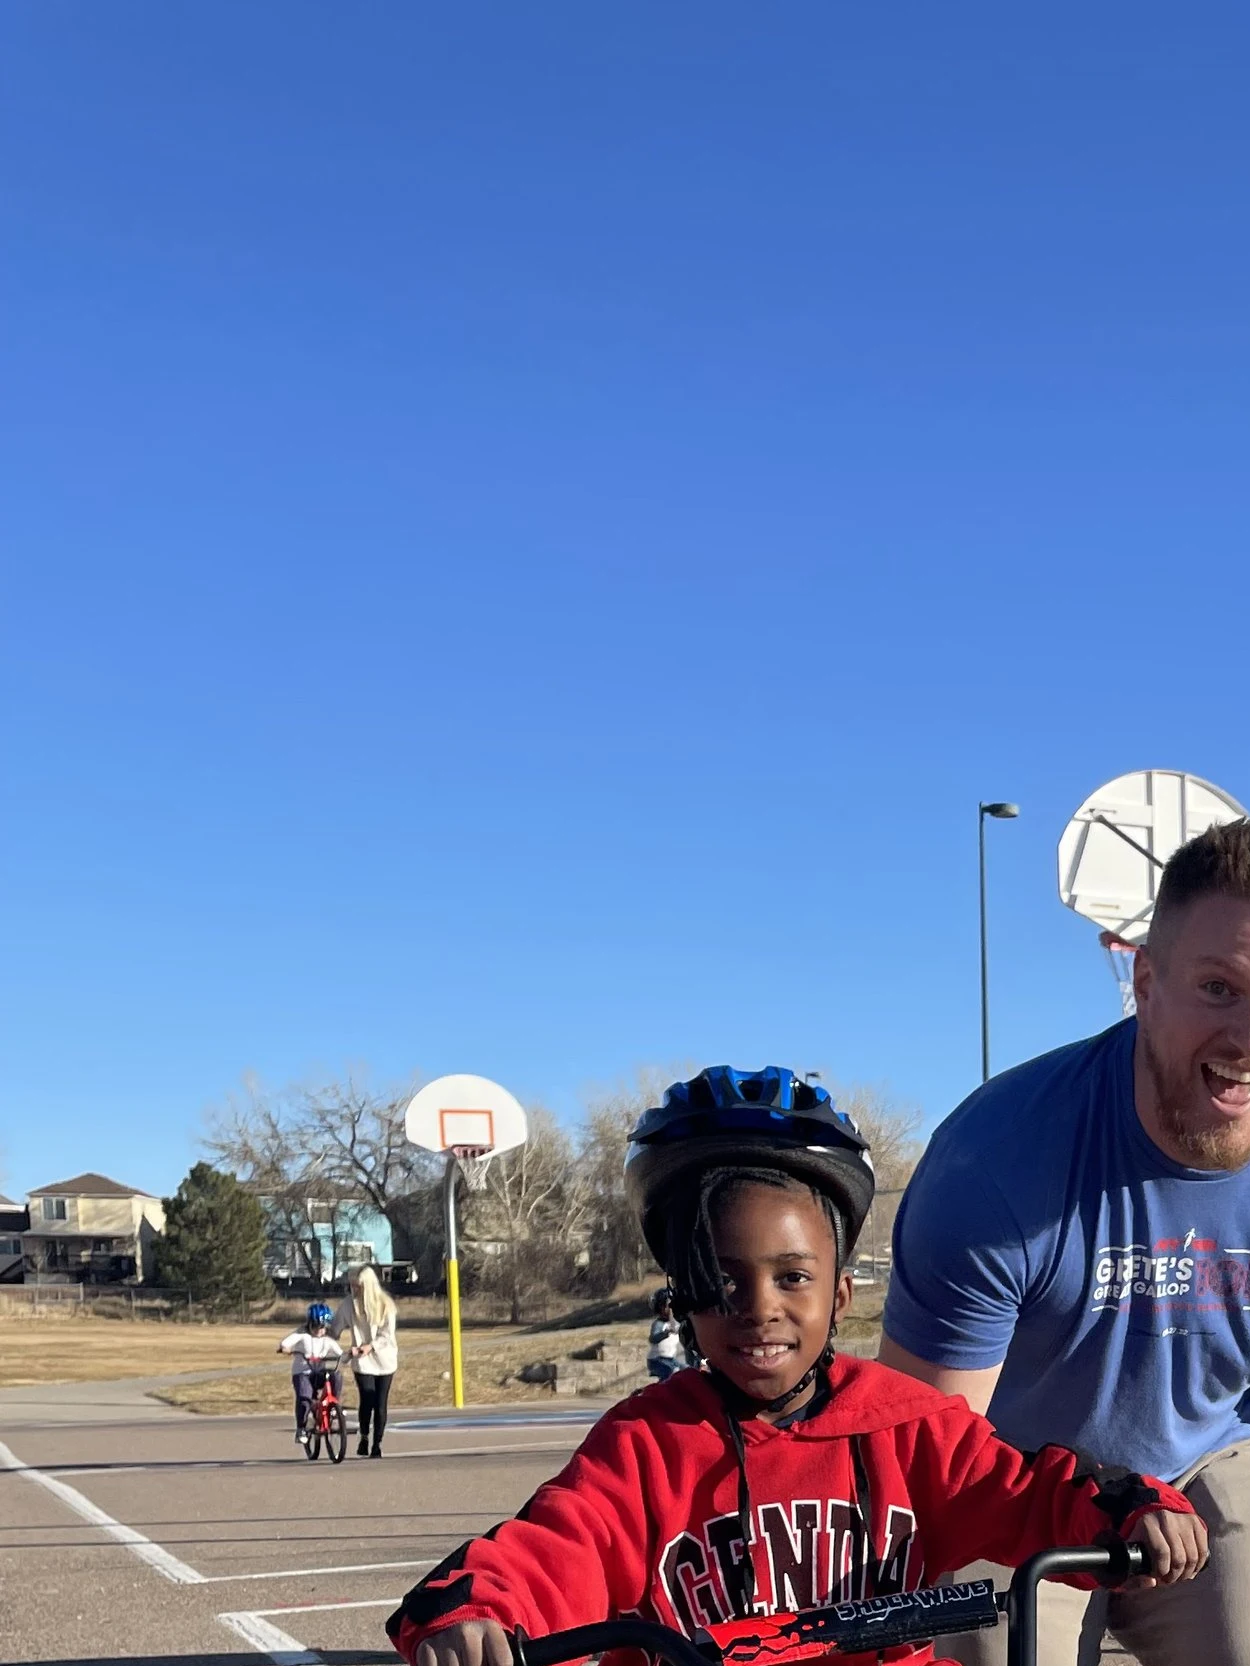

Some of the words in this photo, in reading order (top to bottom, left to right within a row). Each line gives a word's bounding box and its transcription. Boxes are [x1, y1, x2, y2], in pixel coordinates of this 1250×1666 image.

[1096, 1254, 1194, 1284] GRETE'S
[1093, 1281, 1132, 1301] GREA
[1133, 1281, 1190, 1298] GALLOP
